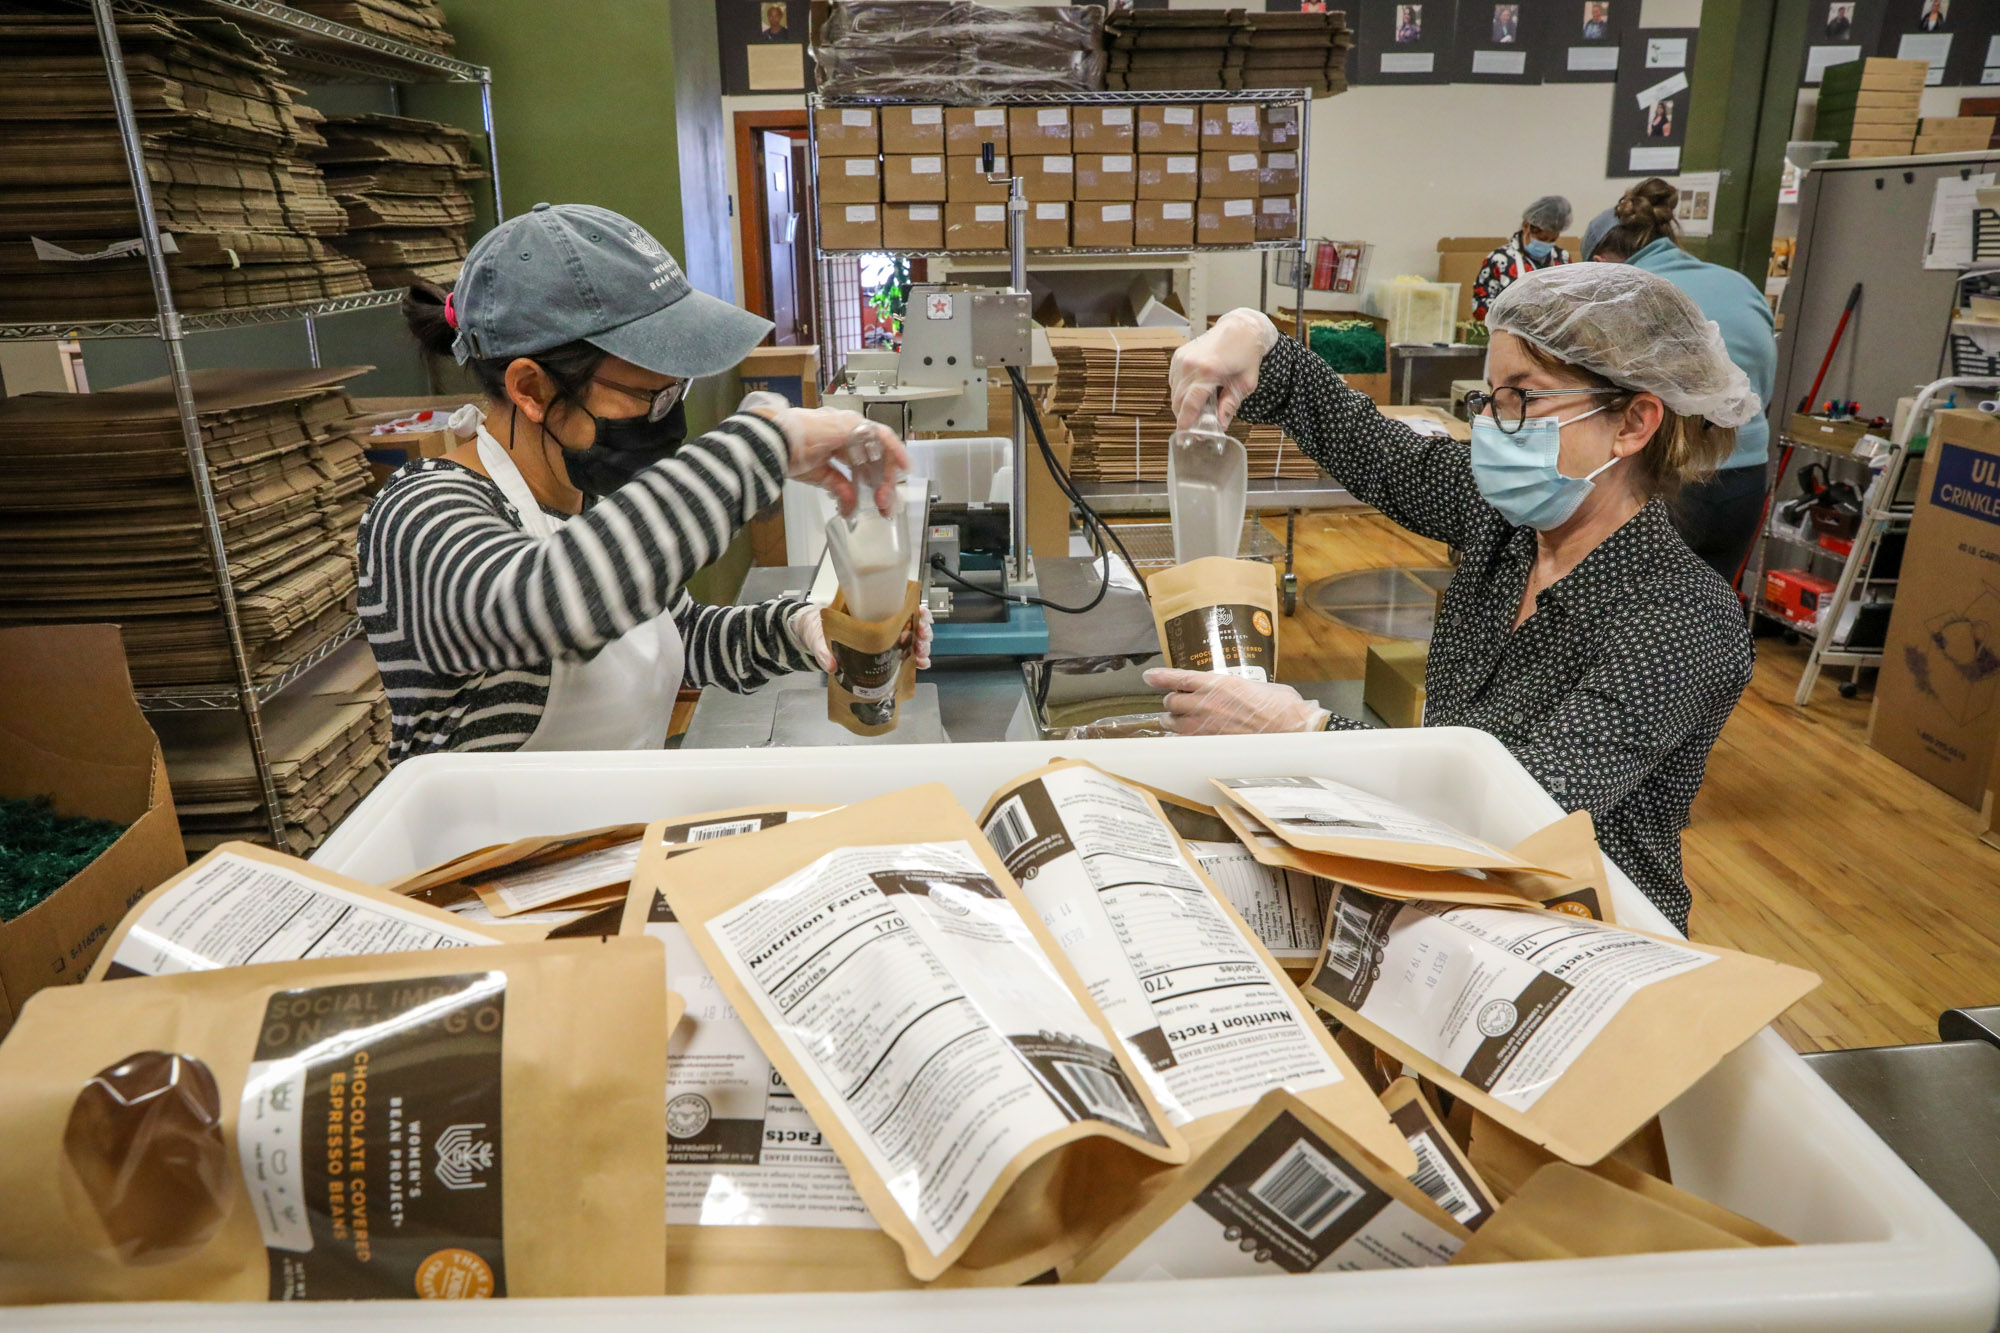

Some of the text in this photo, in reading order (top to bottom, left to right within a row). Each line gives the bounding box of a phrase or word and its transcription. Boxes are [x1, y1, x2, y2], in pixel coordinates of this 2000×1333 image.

[748, 884, 877, 969] Nutrition Facts
[778, 905, 810, 929] COVERED
[1256, 900, 1264, 933] Carbohydrate
[777, 915, 905, 1009] Calories 170
[1402, 941, 1429, 983] 11 19 22
[1511, 937, 1538, 958] 170
[1552, 949, 1594, 977] Facts
[1142, 963, 1260, 995] Calories 170
[1423, 950, 1449, 989] BEST BY
[272, 992, 378, 1019] SOCIAL
[1167, 1011, 1292, 1043] Nutrition Facts
[1177, 1028, 1300, 1059] CHOCOLATE COVERED ESPRESSO BEANS
[765, 1129, 822, 1145] Facts
[327, 1072, 348, 1240] ESPRESSO BEANS
[350, 1051, 371, 1262] CHOCOLATE COVERED
[389, 1097, 404, 1222] BEAN PROJECT
[408, 1120, 422, 1198] WOMEN'S
[763, 1153, 833, 1163] ESPRESSO BEANS
